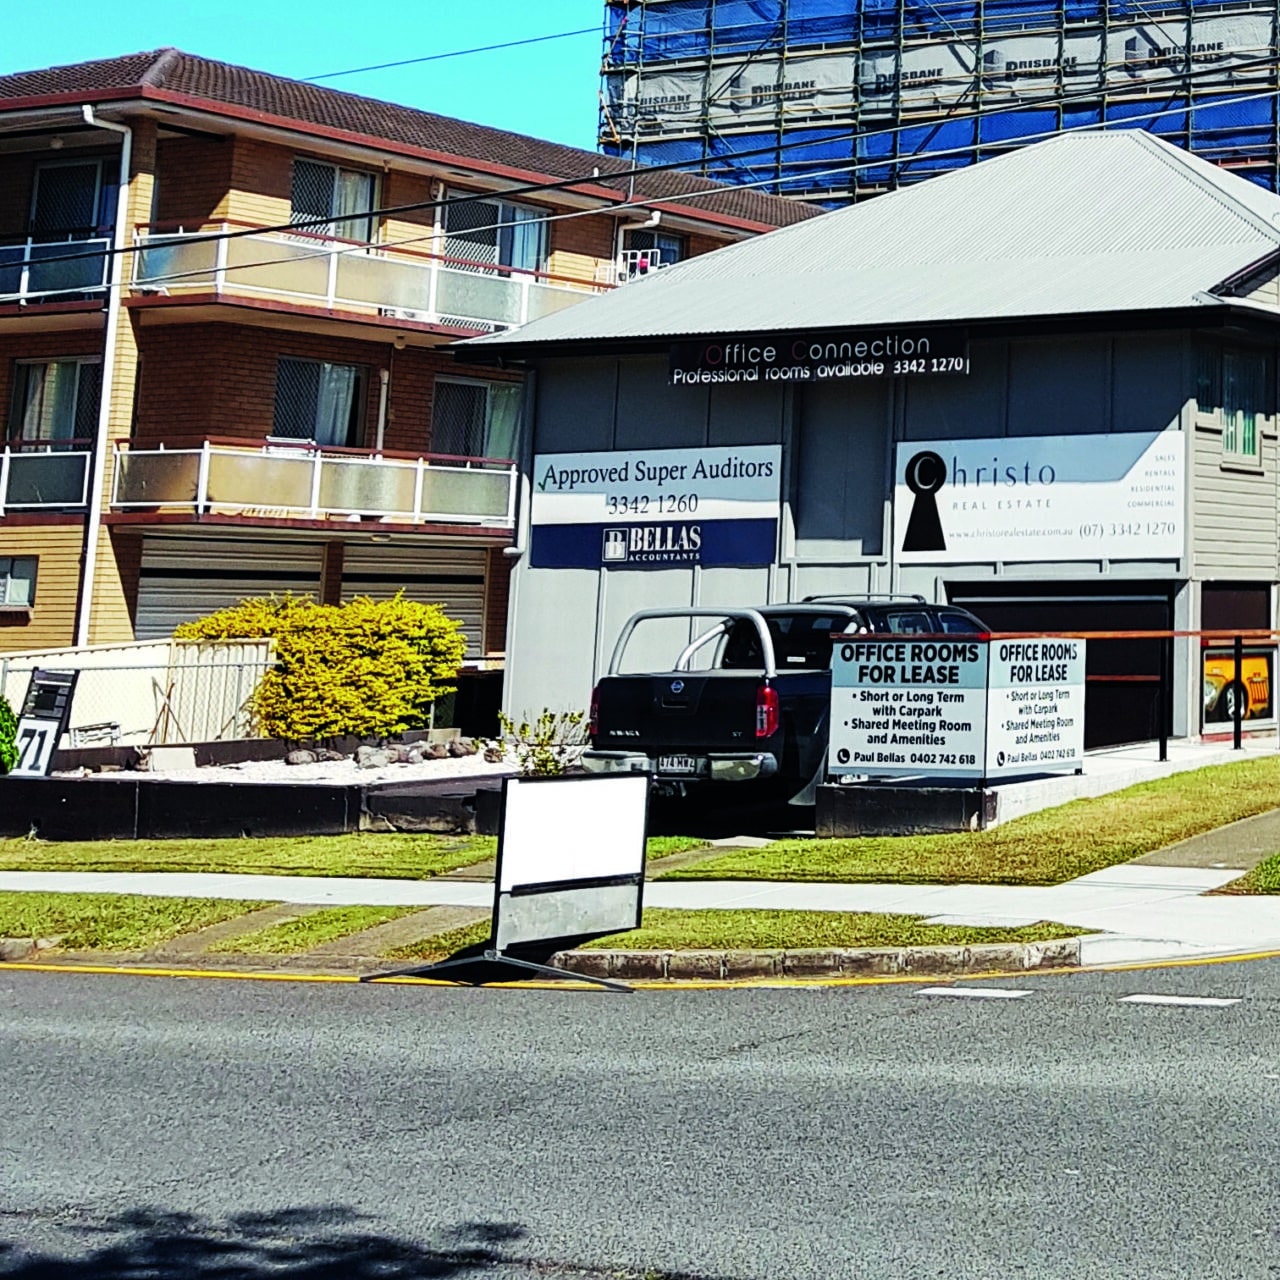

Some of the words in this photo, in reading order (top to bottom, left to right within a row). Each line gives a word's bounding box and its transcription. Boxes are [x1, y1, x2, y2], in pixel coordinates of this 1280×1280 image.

[751, 79, 817, 107] BRIBANE
[705, 344, 777, 365] Office
[791, 336, 930, 361] Connection
[673, 366, 759, 384] Professional
[765, 365, 811, 381] rooms
[816, 361, 885, 377] available
[893, 360, 926, 374] 3342
[931, 357, 964, 371] 1270
[545, 461, 630, 490] Approved
[634, 460, 688, 486] Super
[692, 456, 774, 480] Auditors
[608, 495, 650, 515] 3342
[656, 493, 699, 514] 1260
[952, 499, 988, 511] REAL
[997, 498, 1052, 509] ESTATE
[1127, 500, 1176, 509] COMMERCIAL
[949, 525, 1073, 539] www.christorealestate.com.au
[1079, 523, 1104, 538] (07)
[1111, 522, 1142, 537] 3342
[1146, 520, 1176, 536] 1270
[629, 525, 701, 552] BELLAS
[629, 552, 701, 562] ACCOUNTANTS
[840, 644, 906, 663] OFFICE
[910, 644, 979, 663] ROOMS
[1000, 643, 1039, 662] OFFICE
[1041, 643, 1078, 661] ROOMS
[858, 665, 896, 683] FOR
[900, 665, 960, 684] LEASE
[1010, 665, 1033, 683] FOR
[1035, 664, 1068, 682] LEASE
[859, 690, 890, 702] Short
[891, 693, 904, 702] or
[906, 691, 934, 704] Long
[937, 691, 965, 703] Term
[1010, 690, 1029, 701] Short
[1030, 692, 1037, 700] or
[1038, 690, 1054, 701] Long
[1055, 689, 1070, 700] Term
[872, 704, 896, 716] with
[899, 705, 942, 718] Carpark
[1018, 705, 1033, 715] with
[1033, 703, 1058, 715] Carpark
[851, 718, 889, 730] Shared
[892, 719, 936, 732] Meeting
[939, 719, 972, 732] Room
[1006, 719, 1029, 731] Shared
[1030, 718, 1055, 730] Meeting
[1056, 717, 1074, 727] Room
[867, 733, 888, 744] and
[890, 733, 946, 745] Amenities
[1015, 733, 1028, 744] and
[1029, 731, 1060, 743] Amenities
[16, 728, 48, 772] 71
[1007, 753, 1020, 763] Paul
[1021, 752, 1038, 762] Bellas
[1040, 751, 1055, 760] 0402
[1056, 750, 1065, 759] 742
[1066, 748, 1076, 758] 618
[854, 752, 875, 762] Paul
[877, 752, 906, 763] Bellas
[910, 753, 937, 764] 0402
[939, 753, 957, 764] 742
[959, 754, 976, 765] 618
